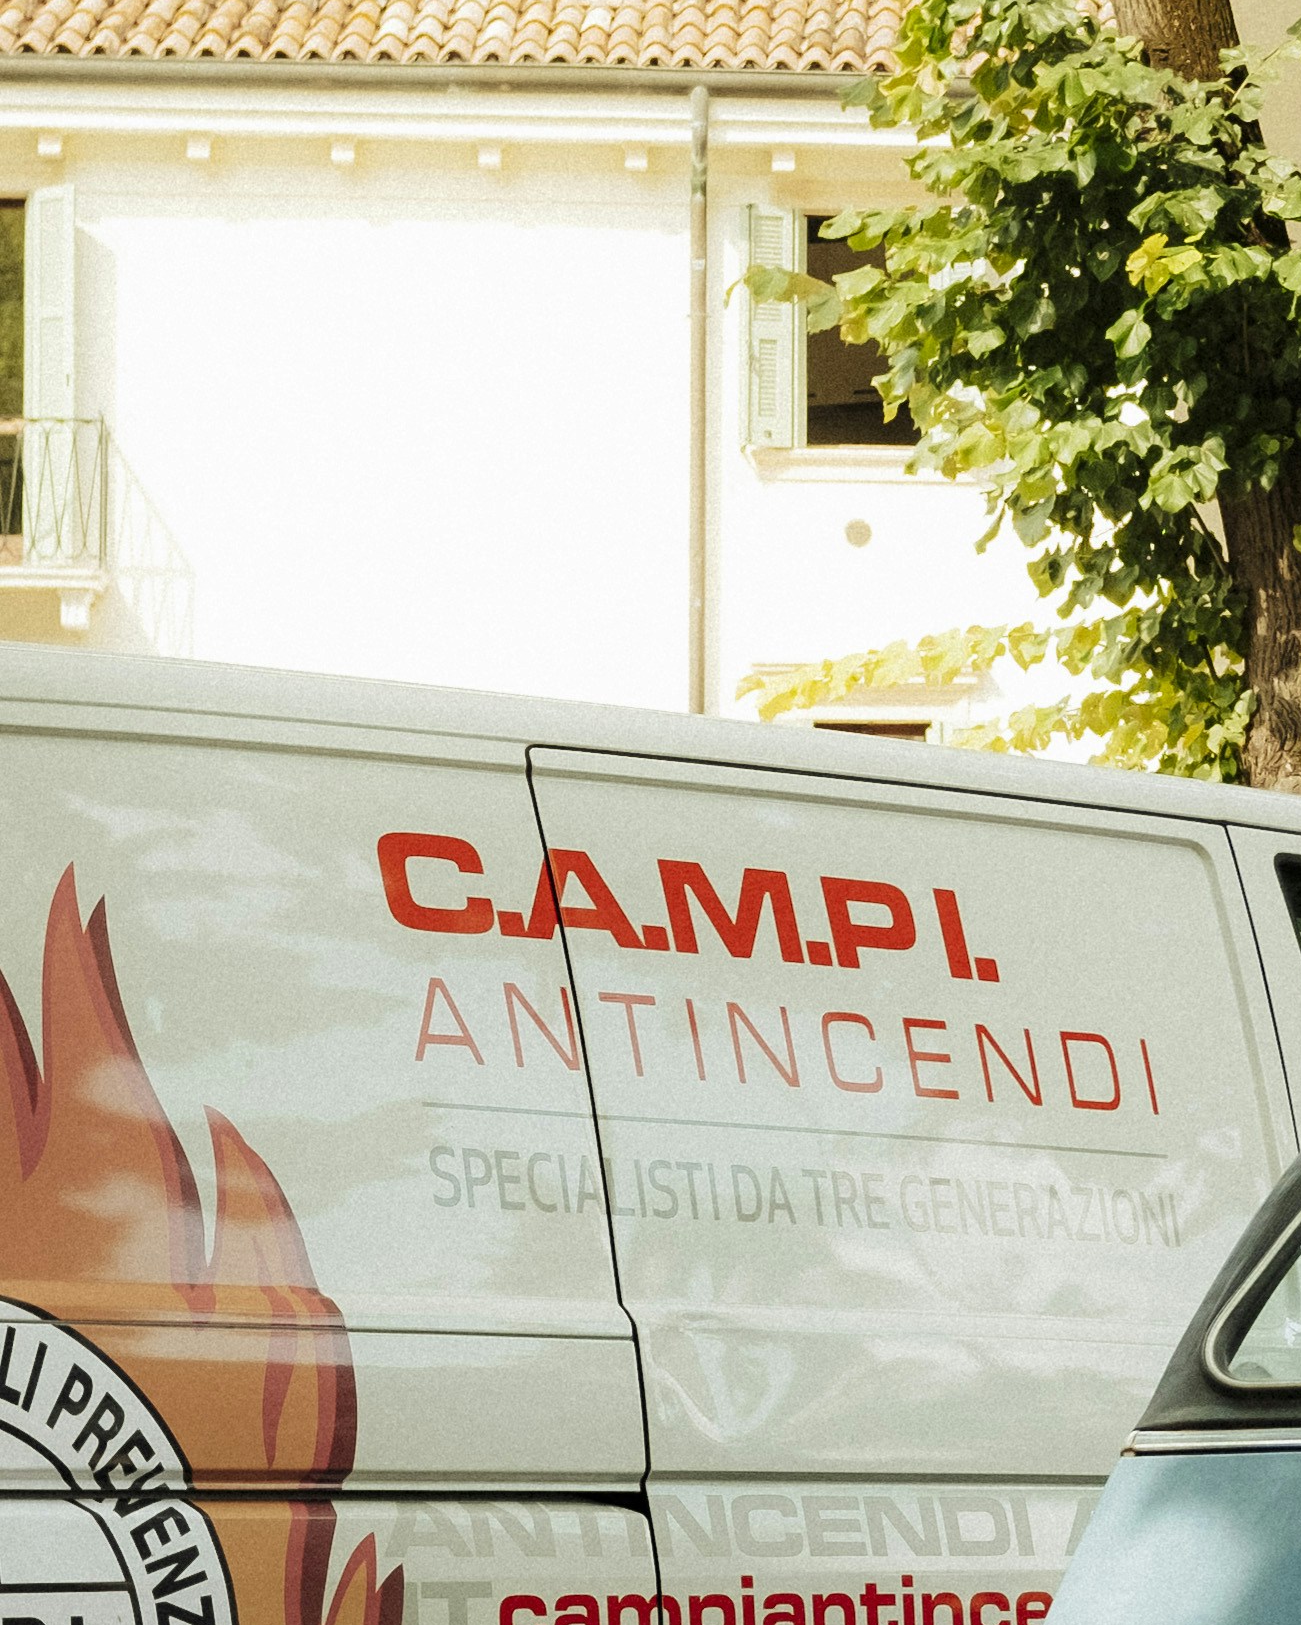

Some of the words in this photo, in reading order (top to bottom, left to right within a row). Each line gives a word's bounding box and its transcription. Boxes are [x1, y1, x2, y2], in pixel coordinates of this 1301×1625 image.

[414, 976, 1160, 1116] ANTINCENDI
[427, 1145, 721, 1222] SPECIALISTI
[730, 1164, 798, 1225] DA
[801, 1168, 891, 1230] TRE
[899, 1173, 1182, 1248] GENERAZIONI
[384, 1493, 1036, 1559] ANTINCENDI
